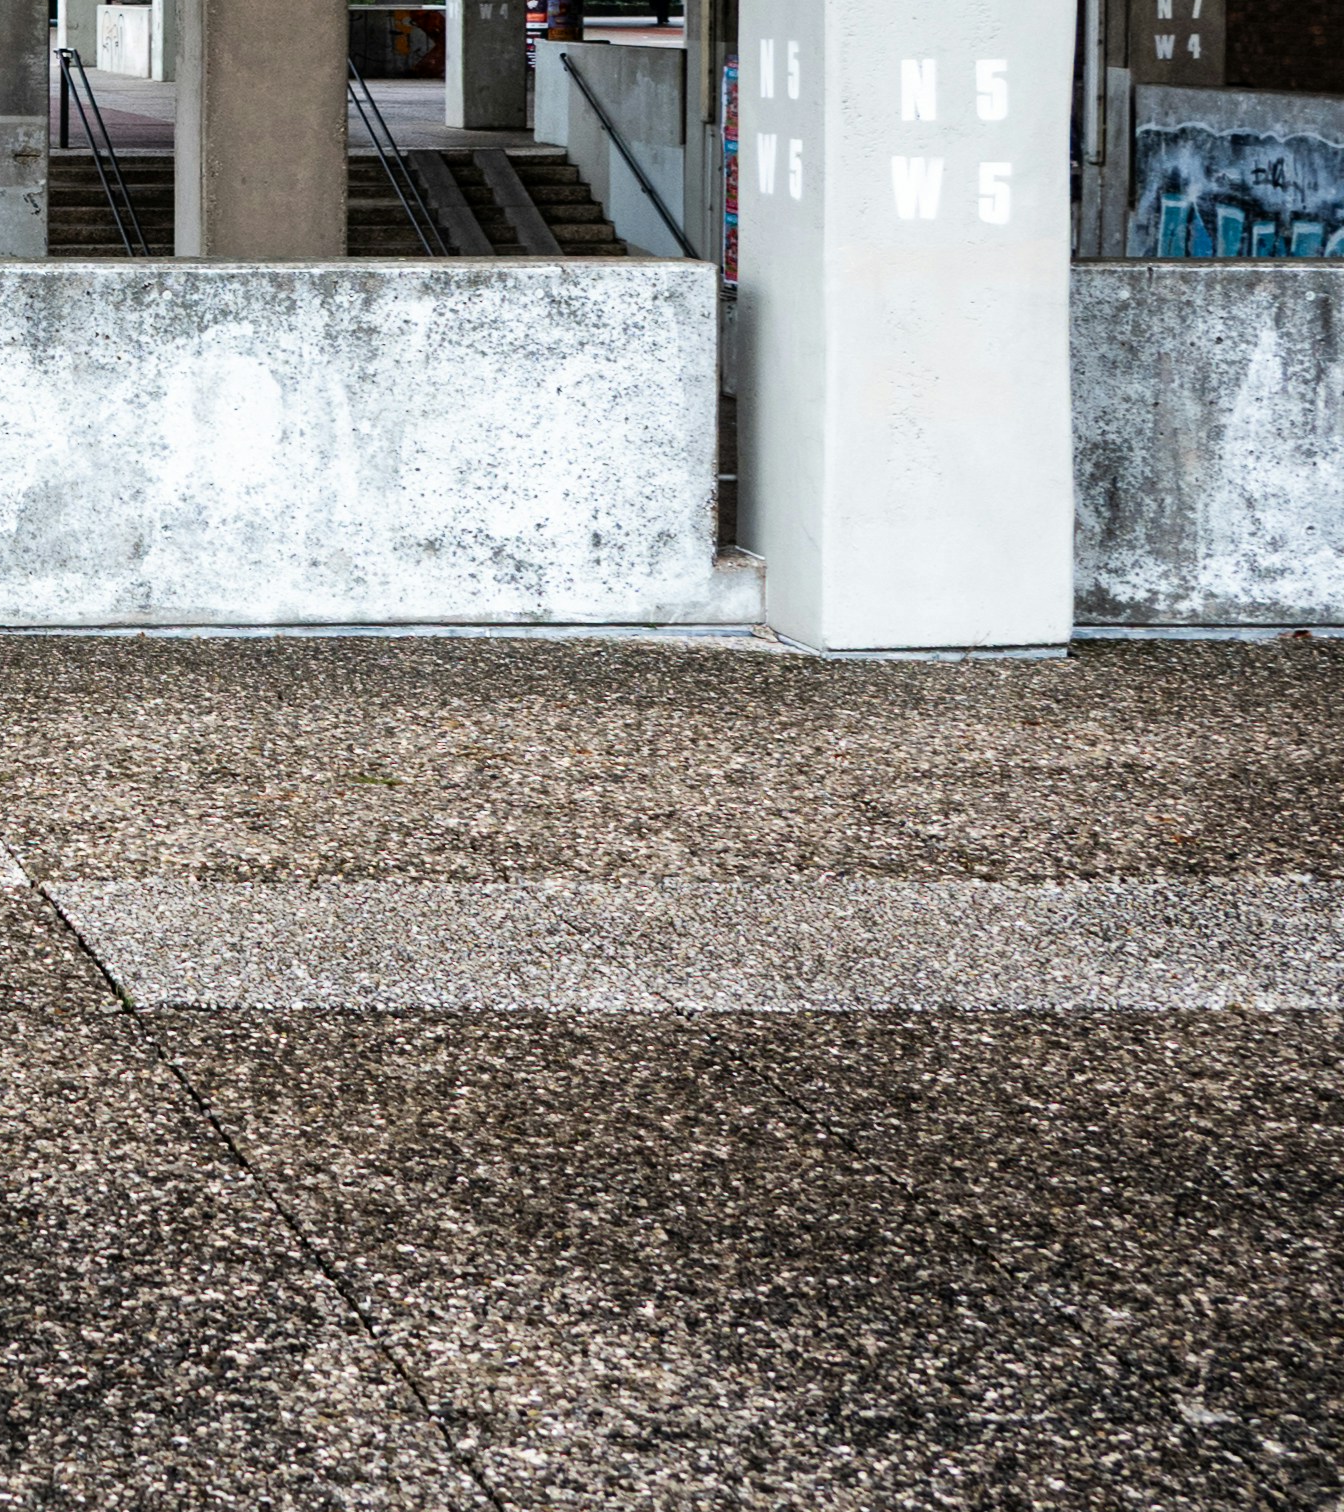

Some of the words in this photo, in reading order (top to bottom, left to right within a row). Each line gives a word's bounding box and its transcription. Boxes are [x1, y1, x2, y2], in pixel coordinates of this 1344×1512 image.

[760, 38, 774, 99] N
[787, 40, 800, 100] 5
[1154, 34, 1175, 59] W
[1188, 33, 1202, 59] 4
[900, 58, 936, 122] N
[975, 59, 1009, 121] 5
[757, 132, 777, 195] W
[789, 138, 803, 201] 5
[891, 155, 945, 220] W
[978, 162, 1012, 225] 5
